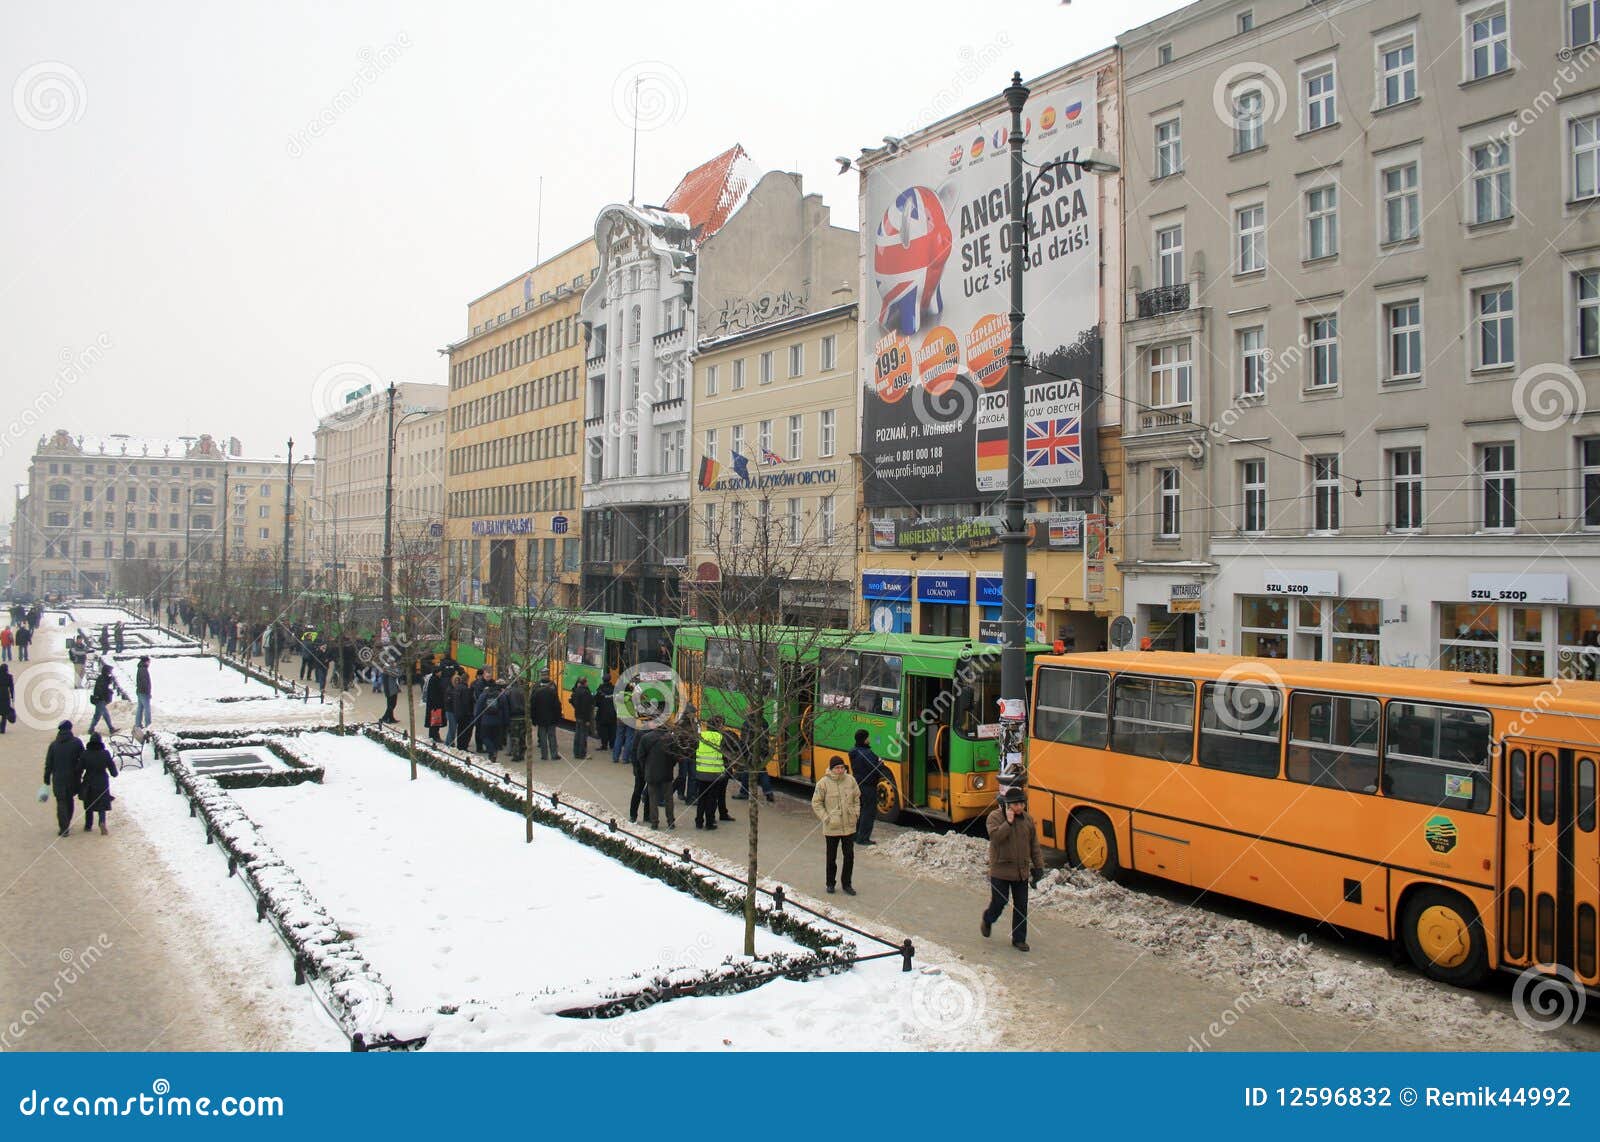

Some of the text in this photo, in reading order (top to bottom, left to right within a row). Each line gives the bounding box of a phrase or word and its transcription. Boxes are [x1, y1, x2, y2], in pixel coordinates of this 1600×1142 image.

[959, 147, 1081, 239] ANGILSKI
[961, 189, 1088, 272] SIĘ OŁACA
[963, 273, 990, 297] Ucz
[1048, 224, 1089, 261] dziś!
[876, 347, 898, 378] 199
[973, 356, 1009, 382] ogranicze
[1047, 402, 1080, 415] OBCYCH
[876, 422, 909, 442] POZNAŃ,
[798, 469, 837, 486] OBCYCH
[875, 460, 943, 480] www.profi-lingua.pl
[1266, 583, 1309, 595] szu_szop
[1471, 589, 1527, 602] szu_szop
